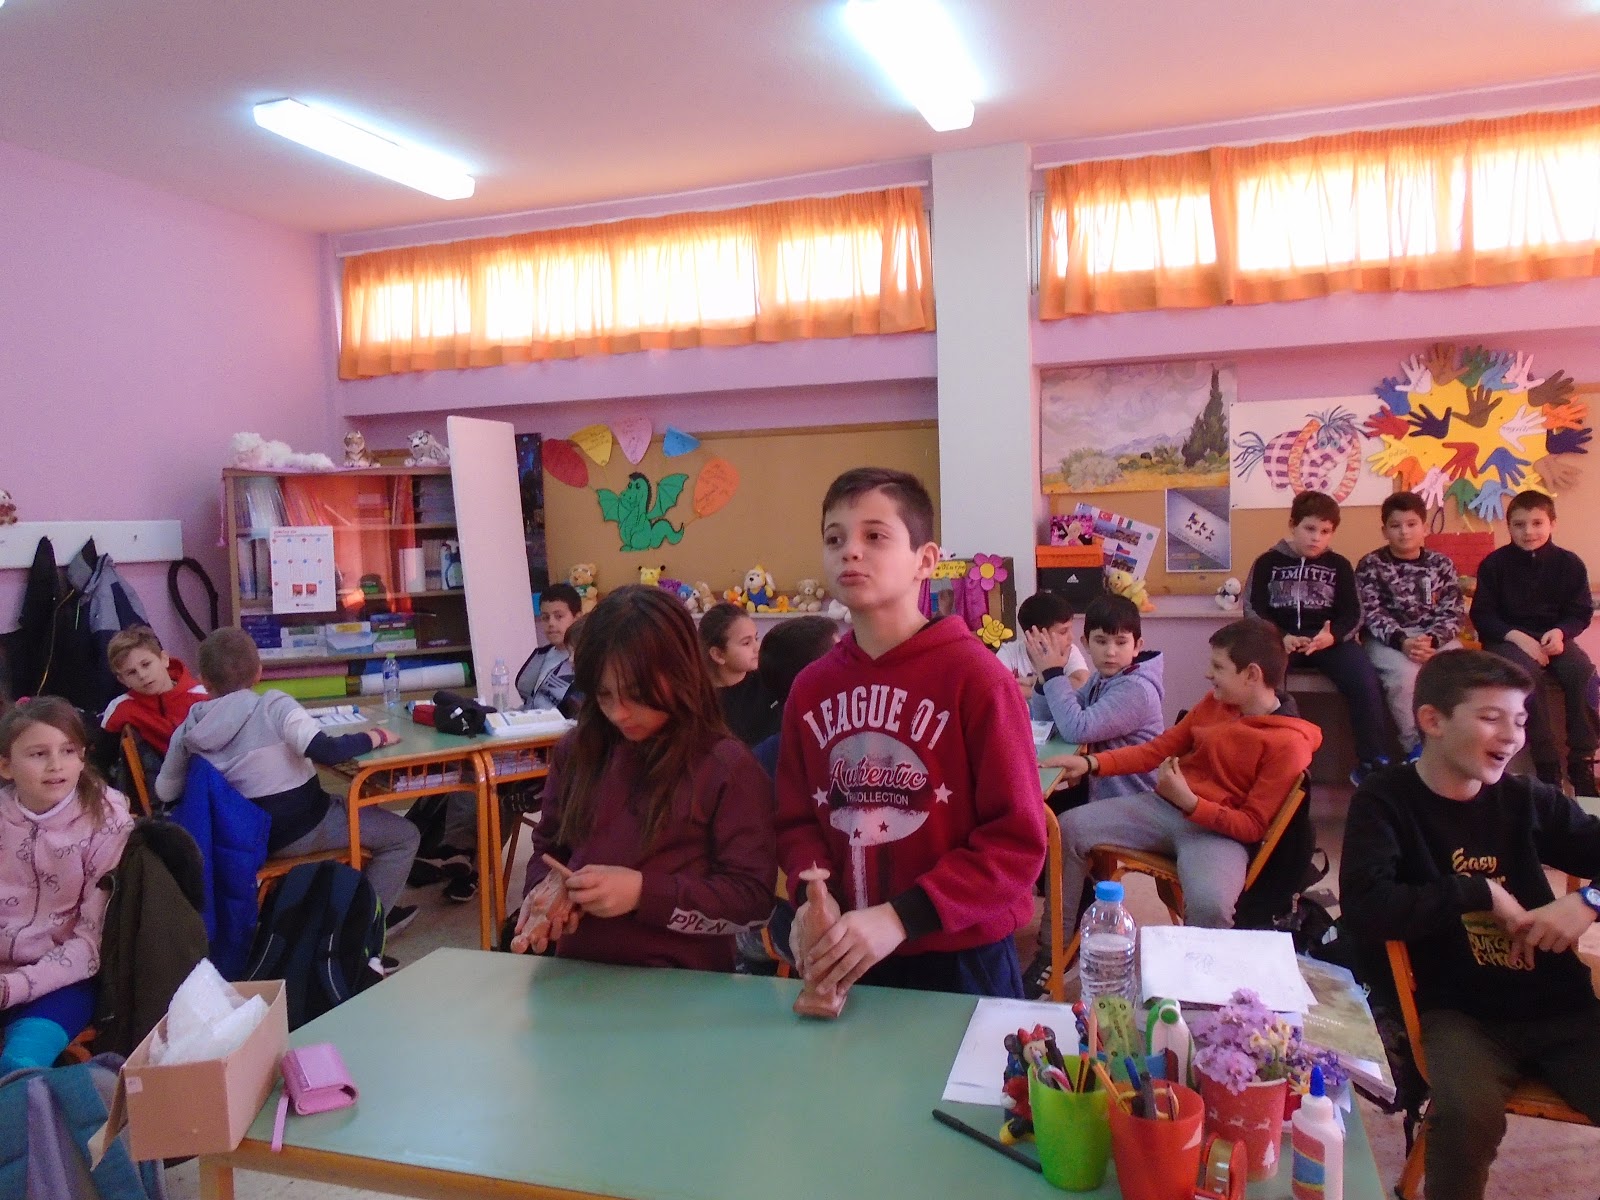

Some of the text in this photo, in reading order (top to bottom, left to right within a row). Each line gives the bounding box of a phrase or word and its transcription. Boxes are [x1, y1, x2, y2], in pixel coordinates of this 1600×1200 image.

[803, 684, 951, 750] LEAGUE 01
[1452, 848, 1497, 873] Easy
